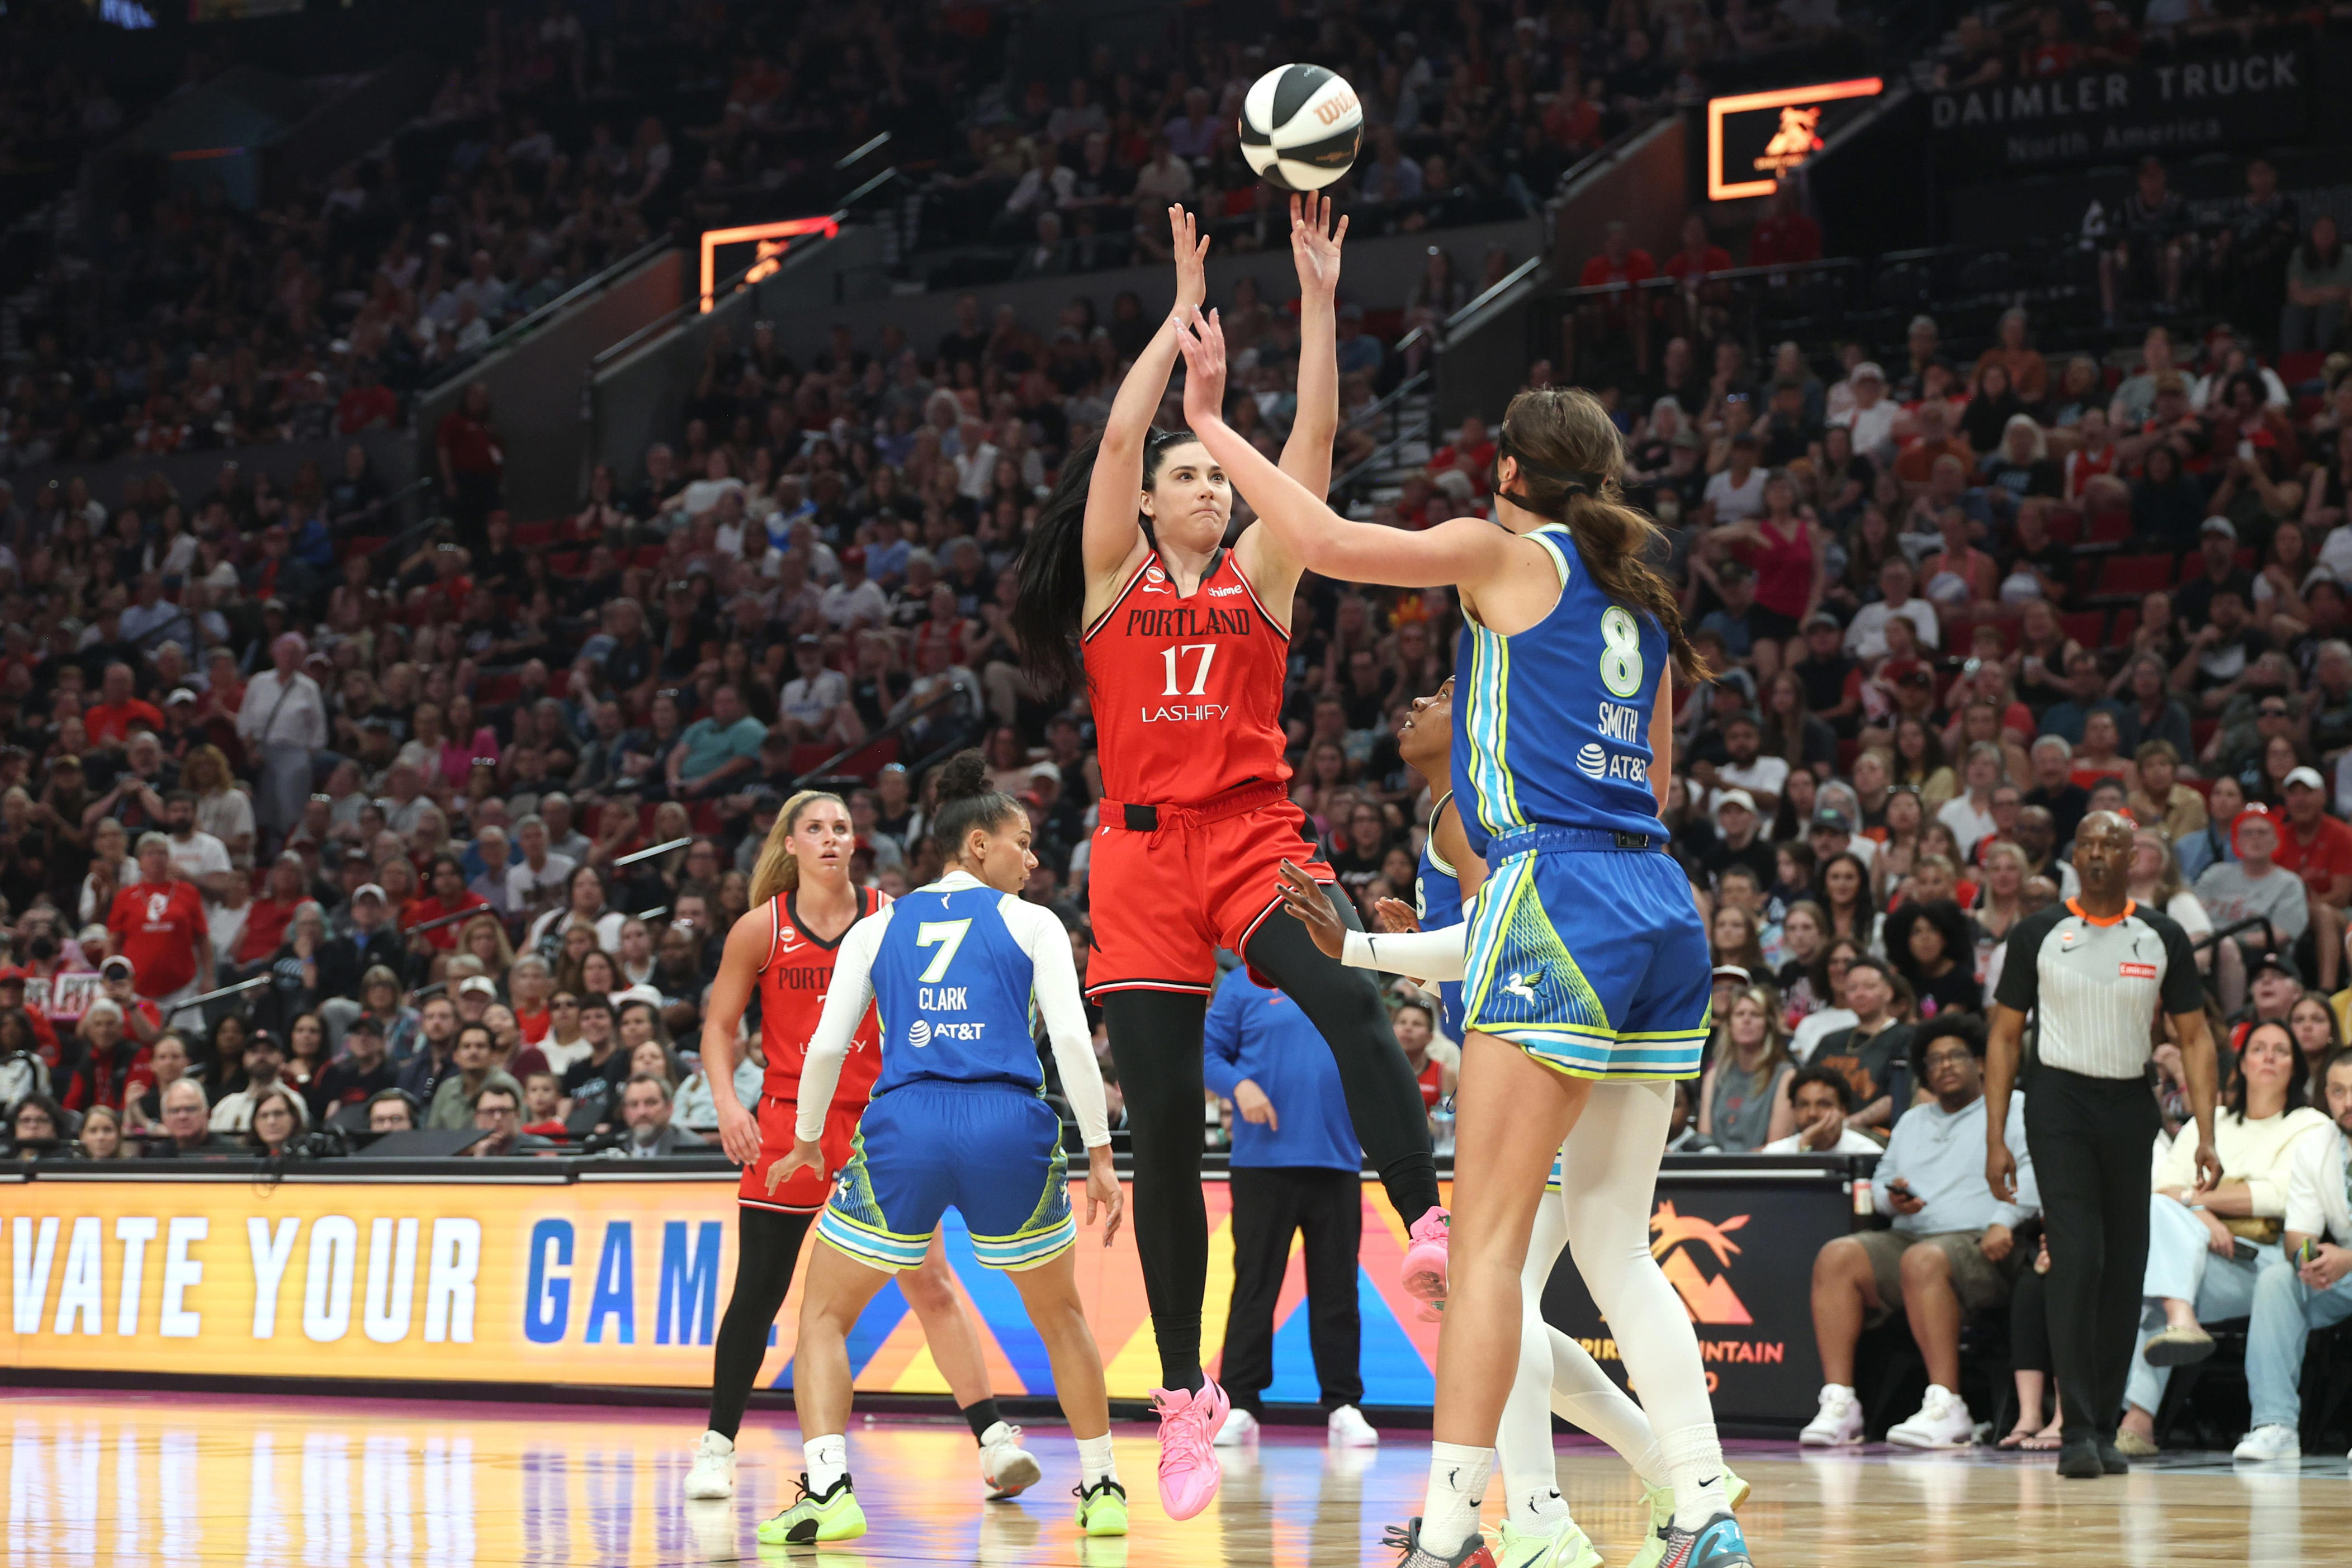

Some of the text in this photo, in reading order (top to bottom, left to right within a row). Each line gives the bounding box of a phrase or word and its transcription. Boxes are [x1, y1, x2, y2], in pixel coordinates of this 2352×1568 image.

[1932, 49, 2298, 129] DAIMLER TRUCK
[1208, 584, 1243, 597] chime
[1126, 607, 1250, 636] PORTLAND
[1599, 605, 1643, 697] 8
[1160, 643, 1217, 696] 17
[1141, 704, 1229, 723] LASHIFY
[1598, 702, 1639, 743] SMITH
[916, 918, 972, 983] 7
[779, 967, 835, 989] PORT
[919, 987, 968, 1011] CLARK
[934, 1022, 986, 1041] AT&T
[0, 1215, 778, 1347] VATE YOUR GAM
[1574, 1337, 1785, 1364] PIR NTAIN
